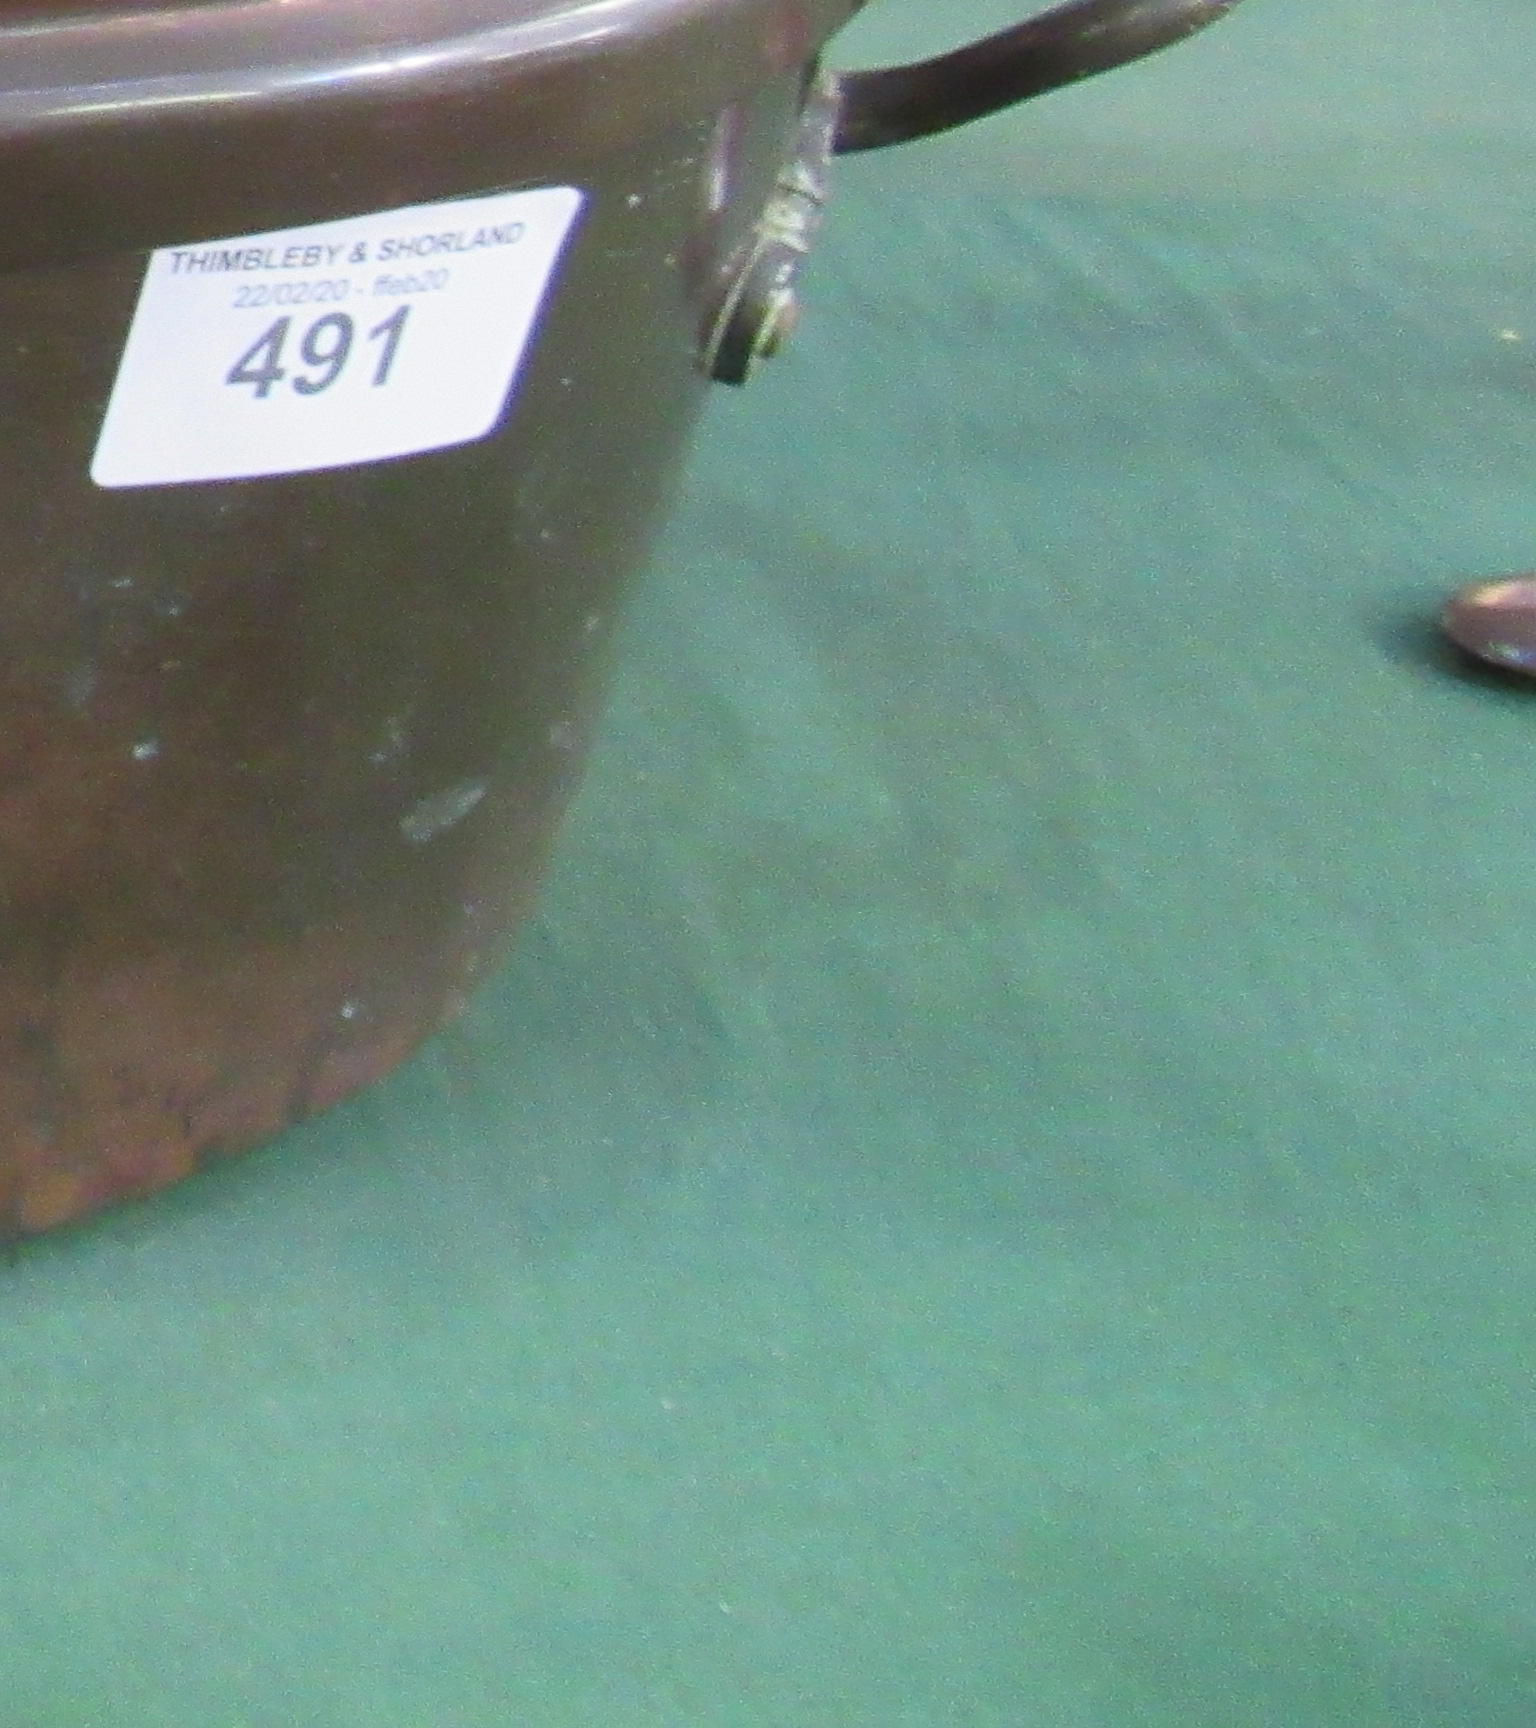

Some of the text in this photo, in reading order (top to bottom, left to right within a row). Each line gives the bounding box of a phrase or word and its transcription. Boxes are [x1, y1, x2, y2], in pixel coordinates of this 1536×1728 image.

[170, 221, 526, 273] THIMBLEBY & SHORLAND
[233, 278, 349, 308] 22/02/20
[224, 304, 412, 398] 491
